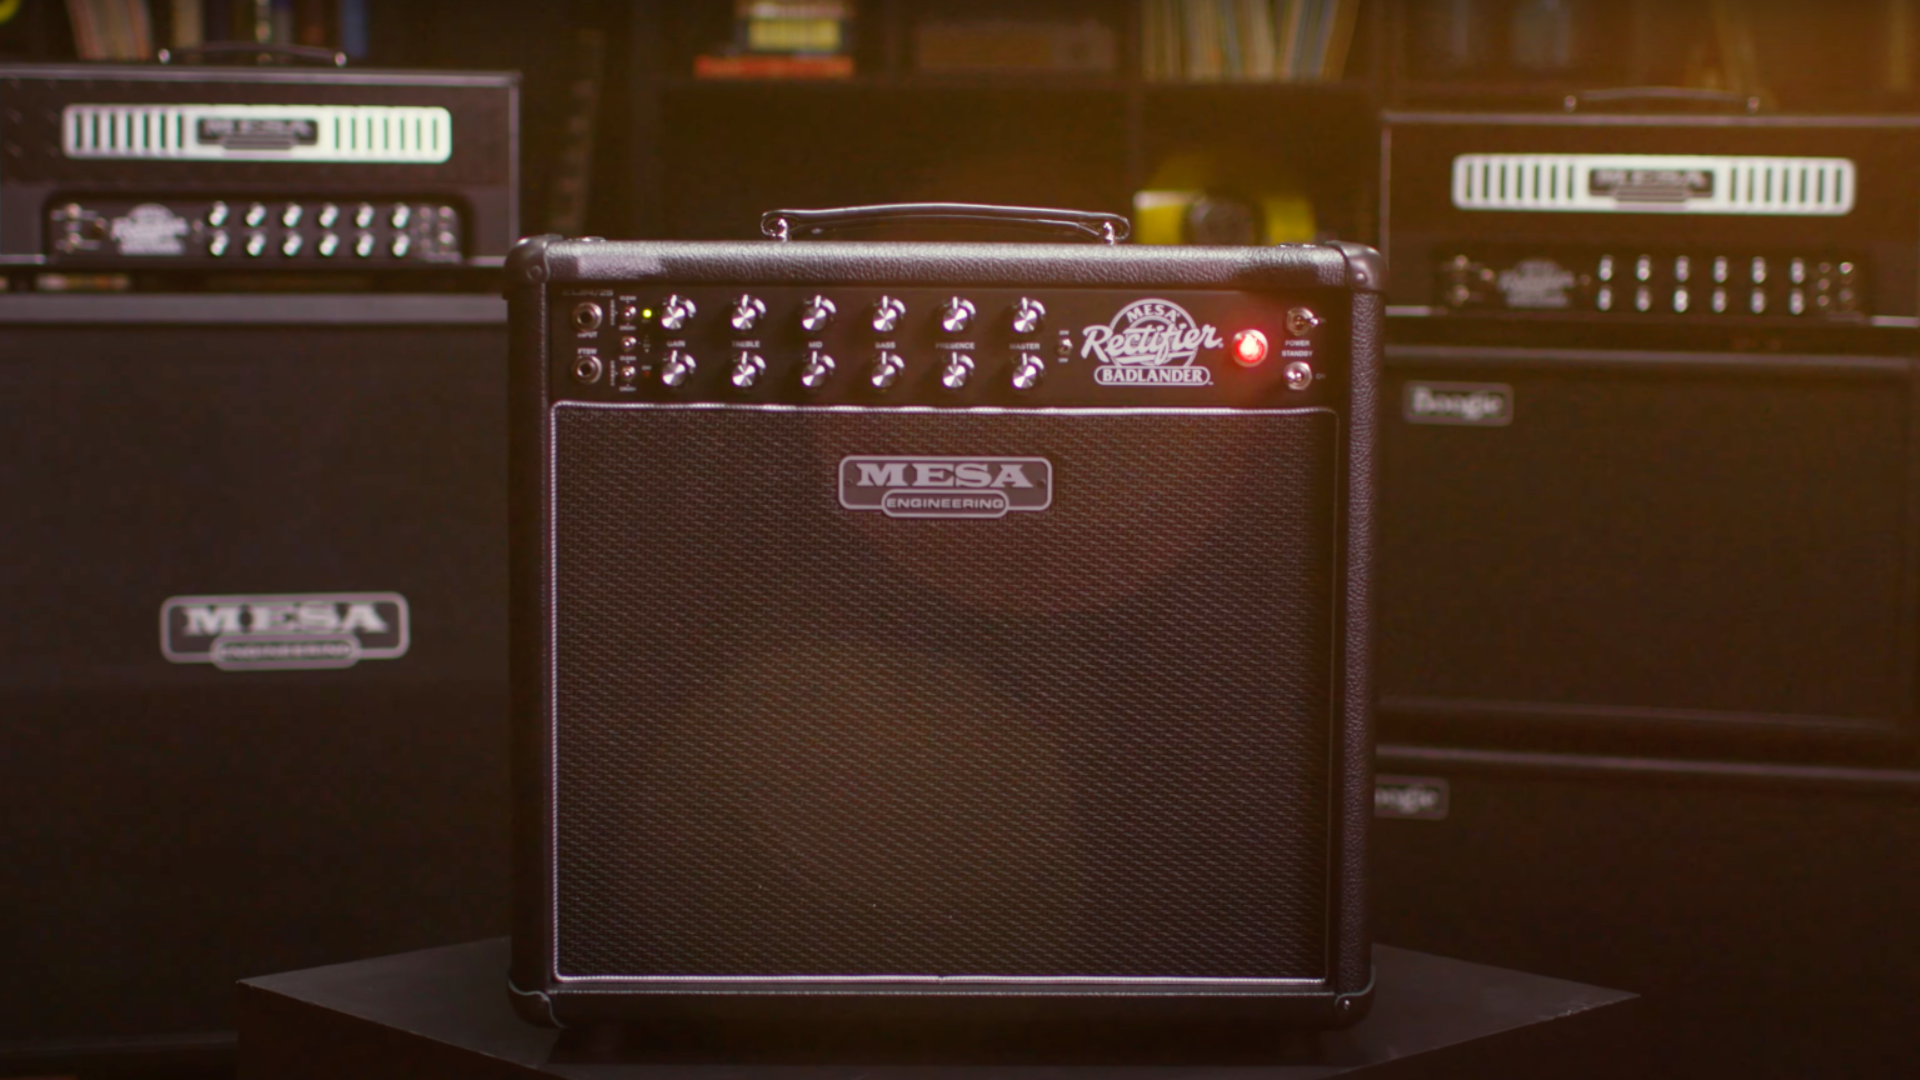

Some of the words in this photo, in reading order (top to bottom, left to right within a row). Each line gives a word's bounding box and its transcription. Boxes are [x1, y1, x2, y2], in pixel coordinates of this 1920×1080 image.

[1126, 304, 1177, 323] MESA
[666, 339, 686, 347] GAIN
[731, 339, 761, 348] TREBLE
[808, 341, 823, 349] MID
[875, 341, 896, 349] BASS
[935, 341, 976, 350] PRESENCE
[1009, 342, 1041, 350] MASTER
[1081, 324, 1222, 365] Rectifier
[1102, 368, 1203, 382] BADLANDER
[1413, 387, 1502, 420] Boogie
[856, 463, 1033, 488] MESA
[886, 498, 1004, 509] ENGINEERING
[185, 602, 388, 635] MESA
[1374, 786, 1438, 814] oogie
